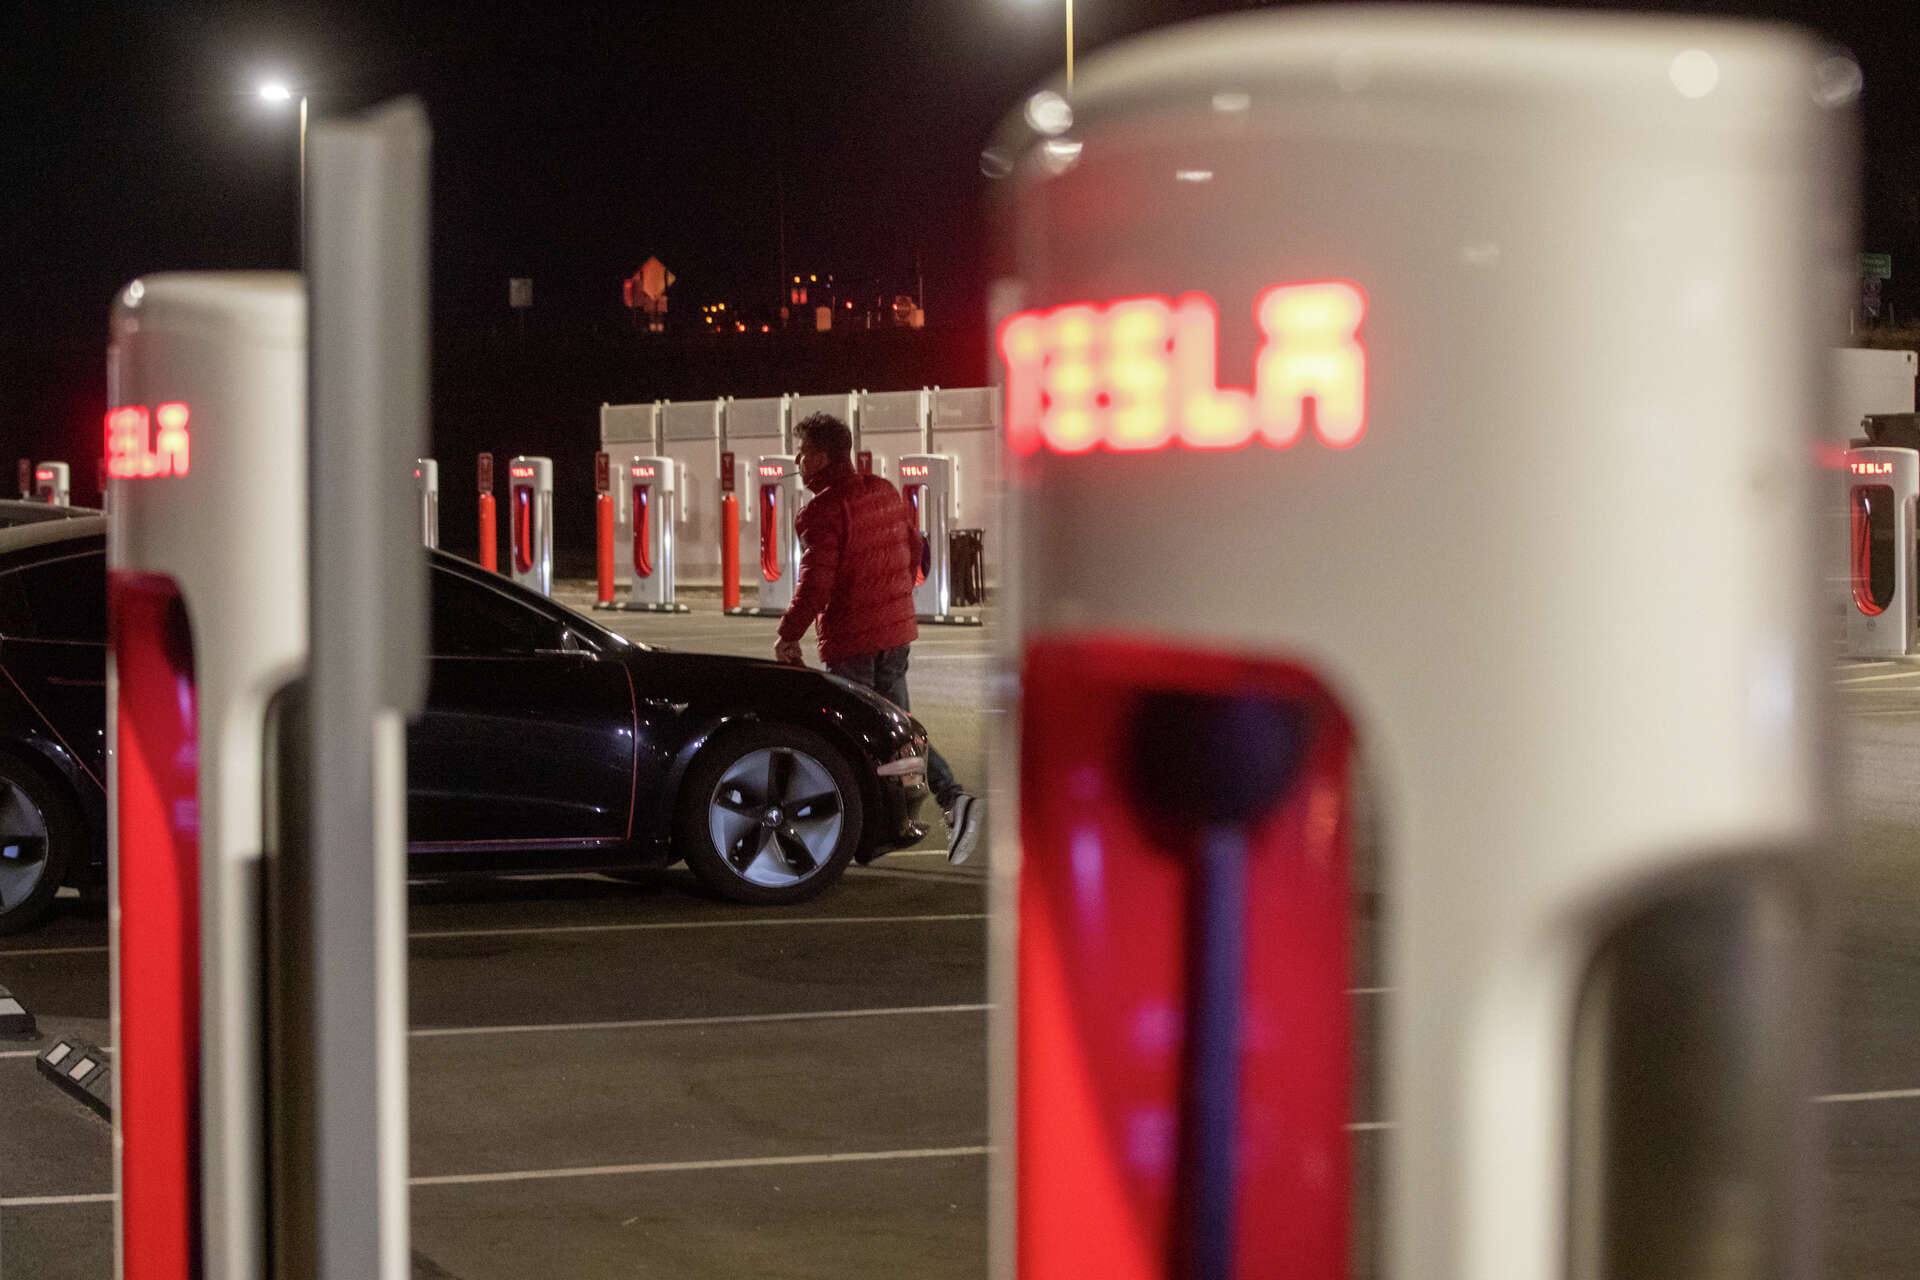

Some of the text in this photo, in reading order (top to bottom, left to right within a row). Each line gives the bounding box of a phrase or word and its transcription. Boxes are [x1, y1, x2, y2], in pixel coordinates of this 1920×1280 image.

[997, 279, 1369, 455] TESLA
[511, 466, 535, 479] TESLA
[631, 466, 655, 478] TESLA
[759, 465, 784, 477] TESLA
[902, 464, 928, 477] TESLA
[1851, 462, 1894, 475] TESLA
